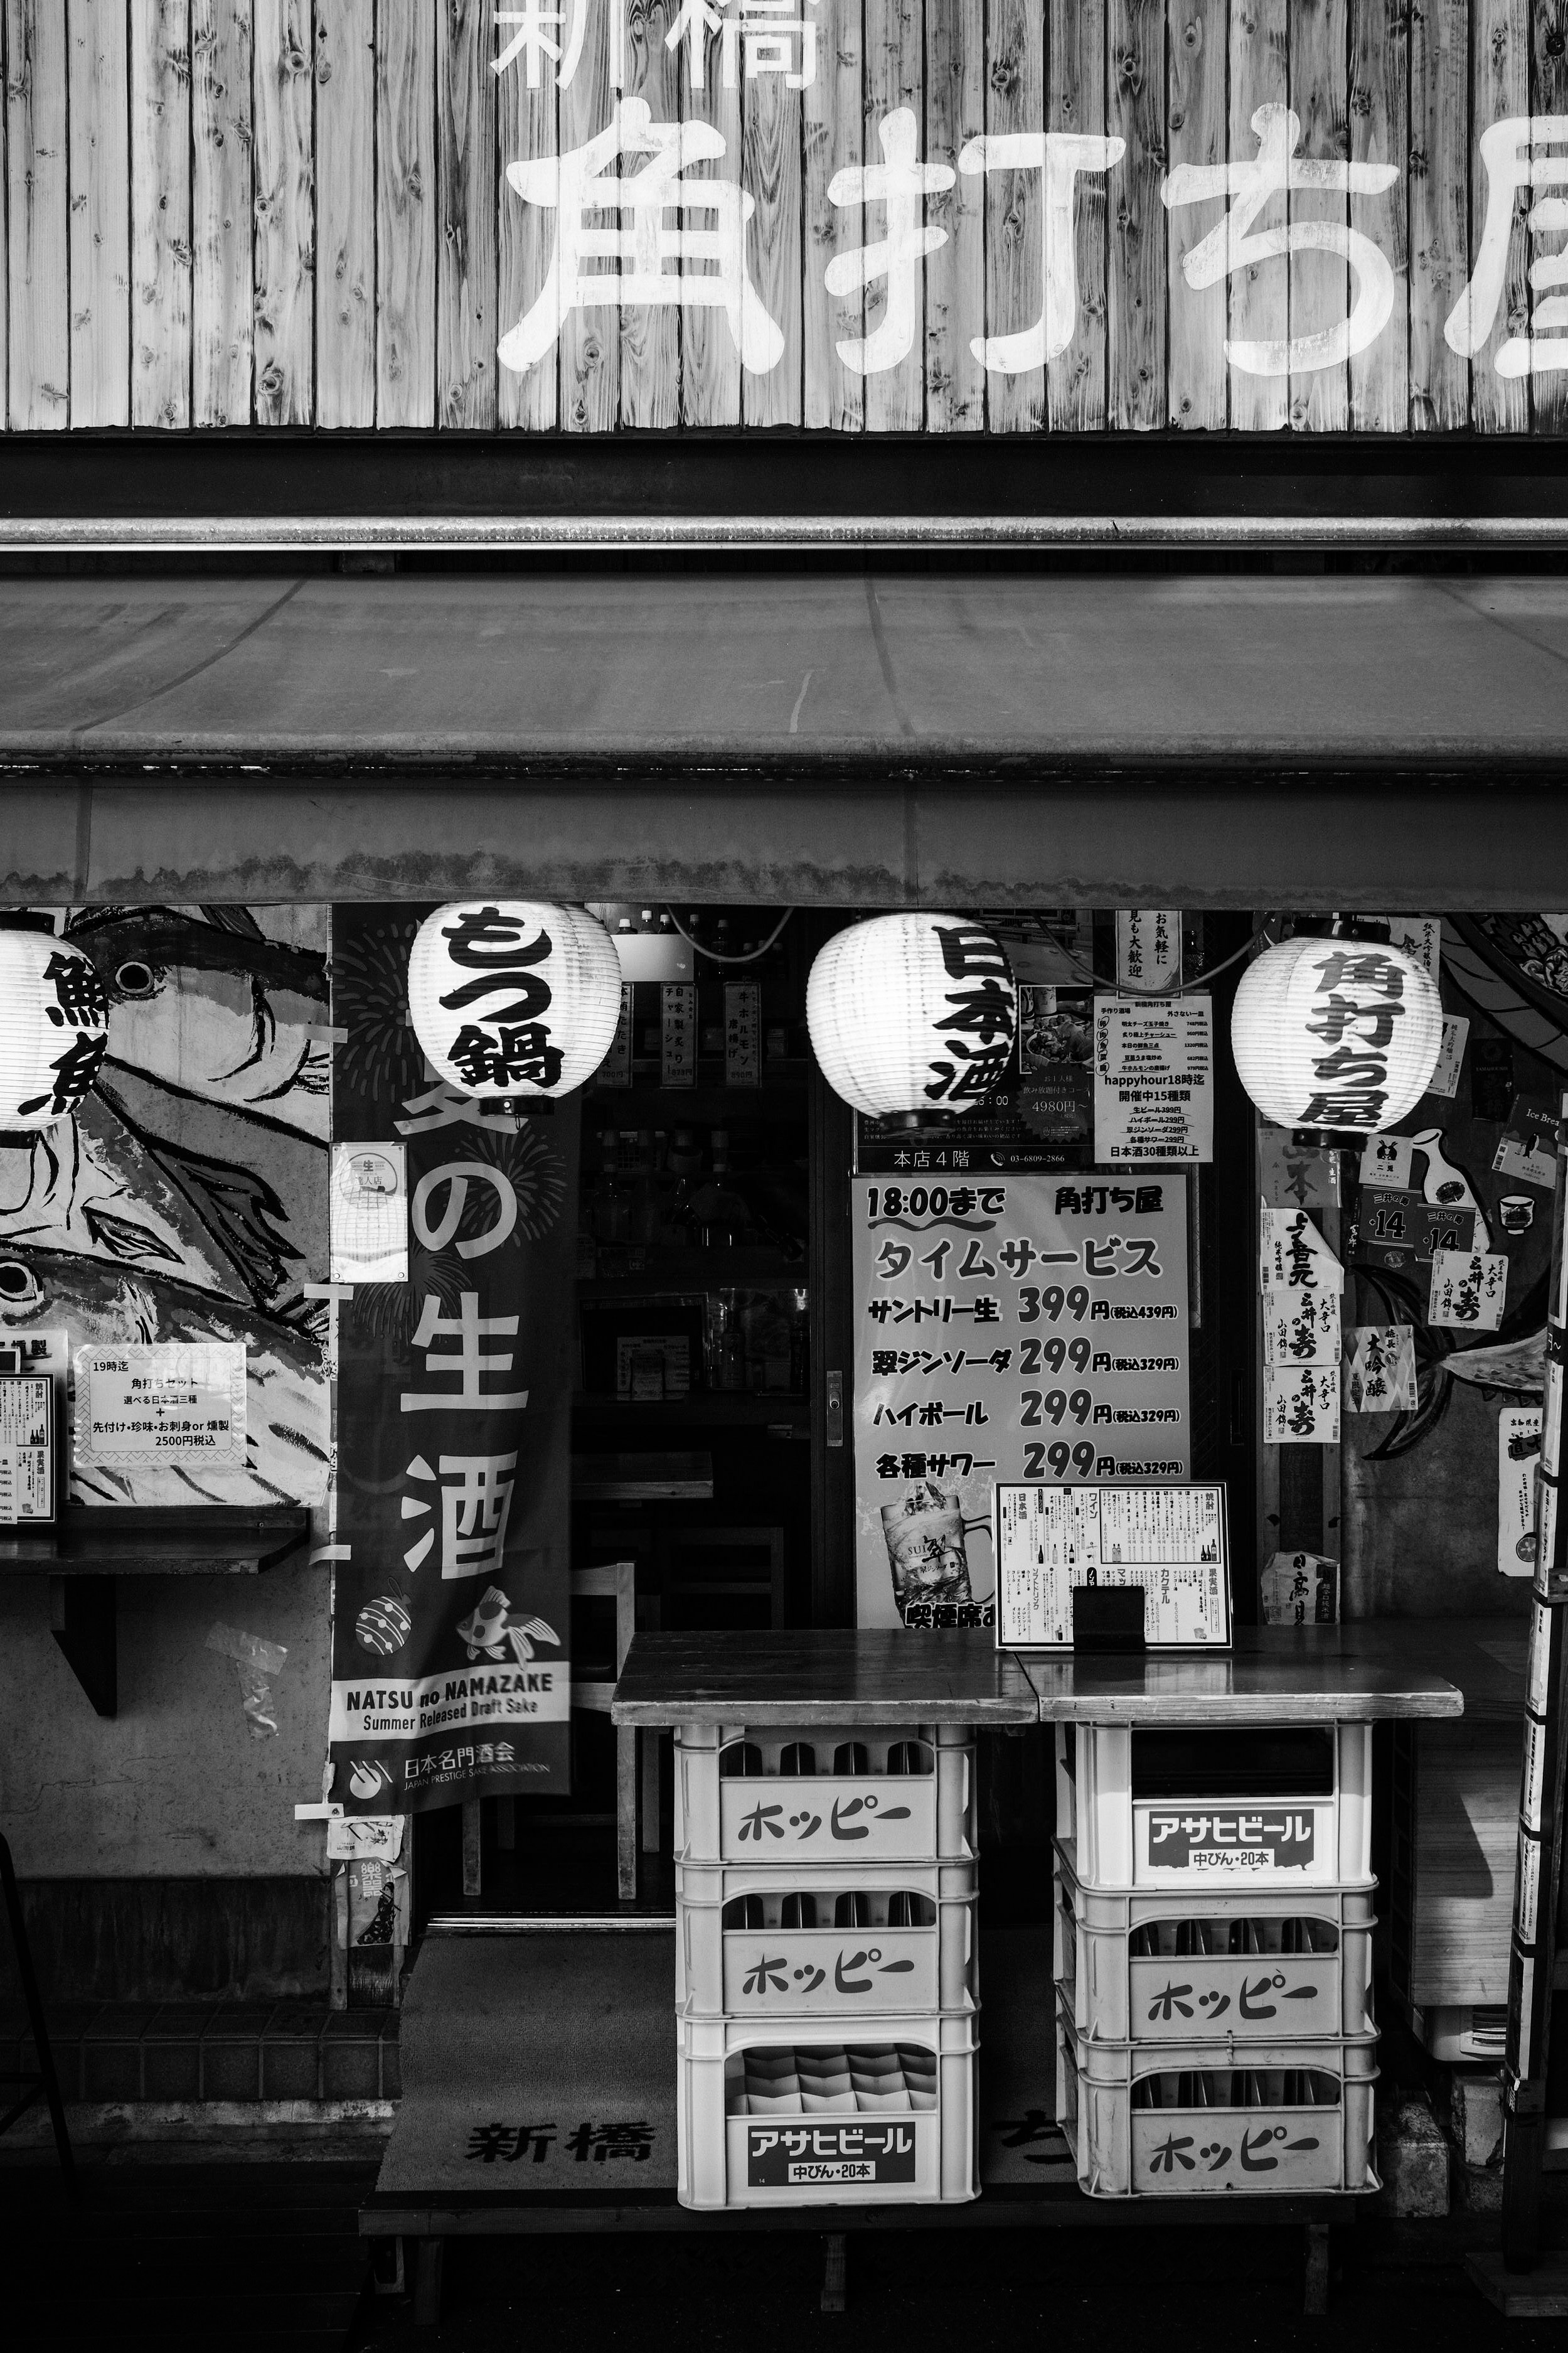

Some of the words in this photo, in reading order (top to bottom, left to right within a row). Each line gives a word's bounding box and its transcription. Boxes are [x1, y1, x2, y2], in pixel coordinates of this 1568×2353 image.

[1155, 913, 1170, 965] お気軽に
[439, 906, 565, 1088] もつ鍋
[924, 926, 1015, 1101] 日本酒
[728, 1019, 739, 1058] 唐揚げ
[739, 992, 749, 1065] 牛ホルモン
[1296, 951, 1408, 1128] 角打ち屋
[1104, 1074, 1205, 1087] happyhour18時迄
[1119, 1090, 1191, 1101] 開催中15種類
[1526, 1108, 1540, 1119] Ice
[363, 1159, 374, 1172] 生
[1111, 1145, 1200, 1157] 日本酒30種類以上
[867, 1186, 1006, 1217] 18:00まで
[1054, 1185, 1164, 1215] 角打ち屋
[1373, 1193, 1411, 1208] 三井の寿
[1427, 1211, 1464, 1226] 三井の寿
[877, 1237, 1163, 1279] タイムサービス
[1441, 1278, 1454, 1310] 山田錦
[1485, 1263, 1498, 1298] 大辛口
[868, 1299, 1000, 1323] サントリー生
[1318, 1298, 1331, 1332] 大辛口
[1276, 1318, 1288, 1351] 山田錦
[93, 1361, 129, 1372] 19時迄
[1365, 1334, 1387, 1397] 大吟醸
[131, 1378, 198, 1390] 角打ちセット
[1318, 1375, 1330, 1410] 大辛口
[124, 1395, 198, 1405] 選べる日本酒三種
[873, 1402, 989, 1427] ハイボール
[1275, 1394, 1287, 1427] 山田錦
[206, 1420, 230, 1432] 燻製
[1510, 1418, 1540, 1427] 高知県産
[155, 1435, 216, 1446] 2500円税込
[875, 1453, 996, 1479] 各種サワー
[1018, 1493, 1028, 1520] 日本酒
[1089, 1493, 1098, 1519] ワイン
[908, 1545, 927, 1556] SUI
[1161, 1568, 1170, 1604] カクテル
[1208, 1568, 1218, 1595] 果実酒
[347, 1690, 413, 1711] NATSU
[420, 1693, 440, 1708] no
[445, 1673, 553, 1701] NAMAZAKE
[363, 1715, 415, 1730] Summer
[420, 1703, 467, 1729] Released
[471, 1699, 503, 1717] Draft
[506, 1697, 538, 1713] Sake
[404, 1742, 516, 1779] 日本名門酒会
[403, 1778, 429, 1791] JAPAN
[431, 1772, 467, 1783] PRESTIGE
[737, 1794, 912, 1841] ホッピー
[1151, 1815, 1311, 1843] アサヒビール
[1193, 1851, 1270, 1867] 中びん・20本
[742, 1948, 915, 1994] ホッピー
[1148, 1973, 1318, 2021] ホッピー
[464, 2121, 656, 2164] 新橋
[750, 2128, 913, 2157] アサヒビール
[1149, 2125, 1320, 2172] ホッピー
[792, 2163, 871, 2180] 中びん・20本
